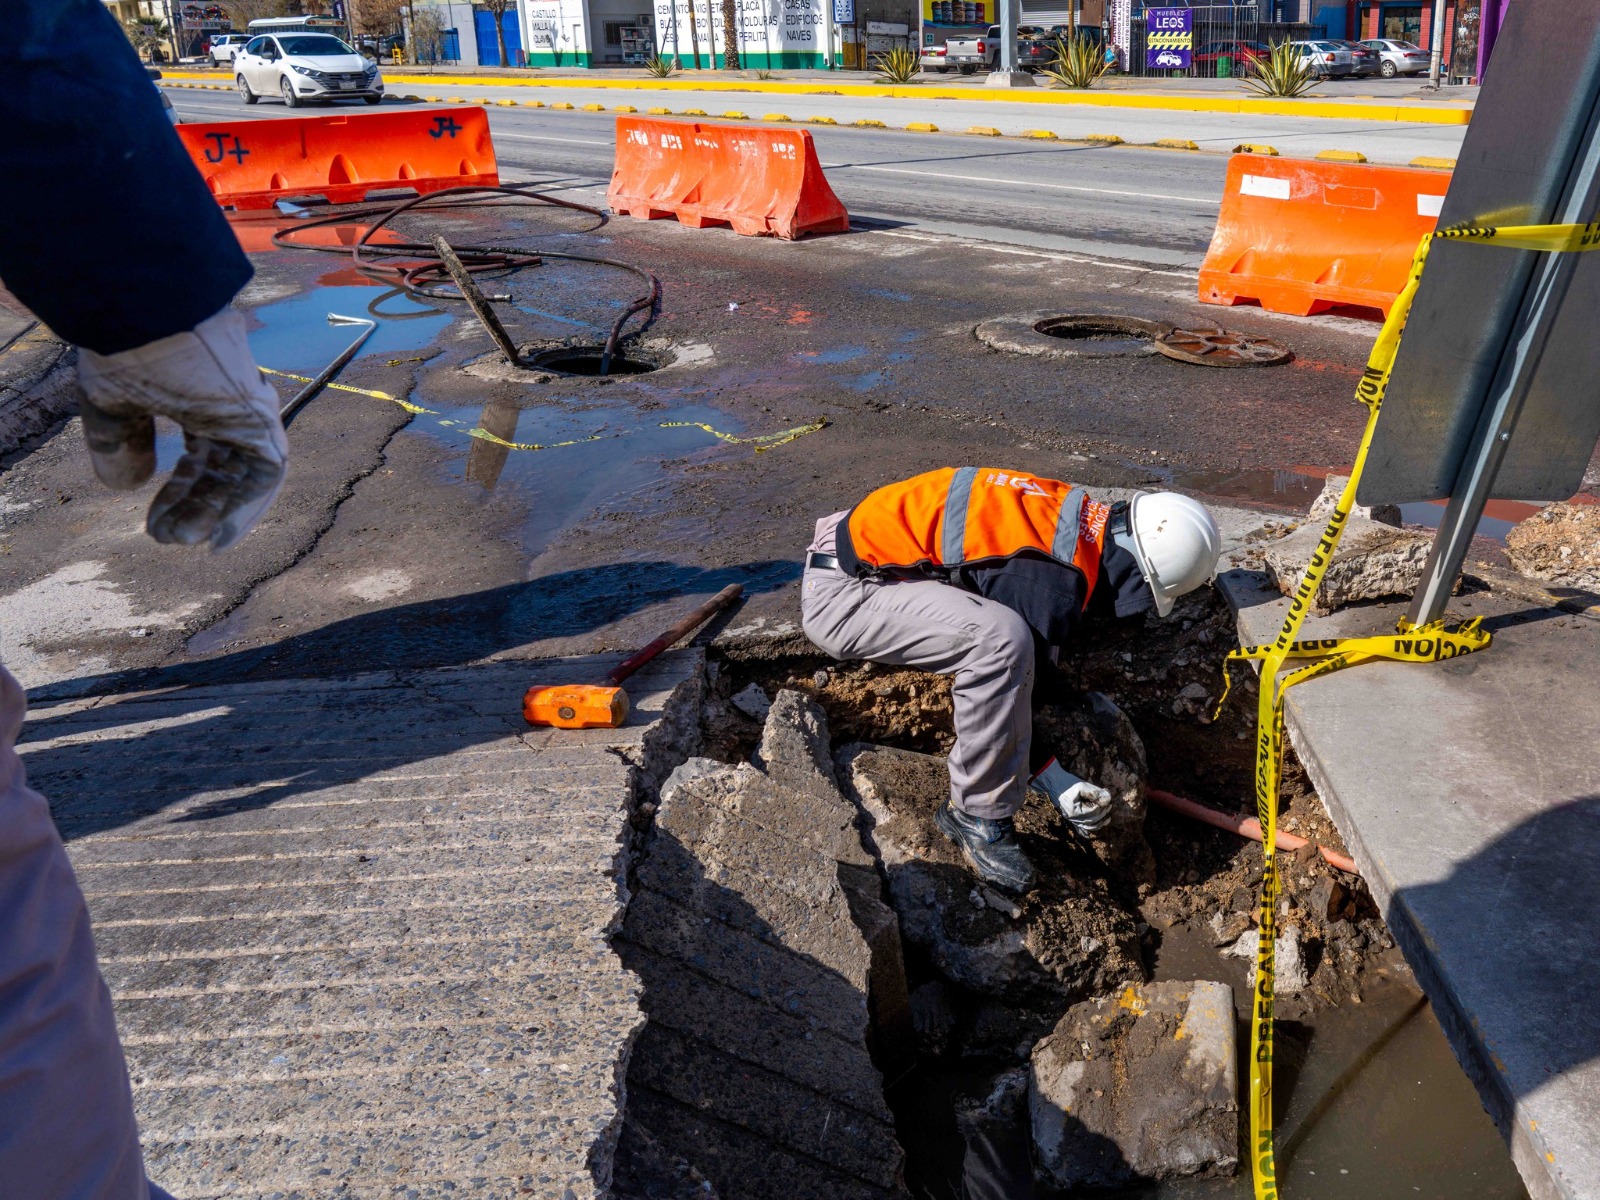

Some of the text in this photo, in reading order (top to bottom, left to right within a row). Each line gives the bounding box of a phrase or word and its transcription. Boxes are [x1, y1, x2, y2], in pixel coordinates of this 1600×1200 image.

[657, 4, 689, 14] CEMNTO
[695, 3, 724, 14] VIGETA
[736, 1, 760, 12] PLACA
[785, 0, 811, 10] CASAS
[532, 9, 556, 18] CASTILLO
[660, 19, 682, 29] BLOK
[737, 15, 778, 27] MOLDURAS
[786, 14, 823, 26] EDIFICIOS
[1156, 17, 1184, 29] LEOS
[739, 31, 767, 41] PERLITA
[786, 30, 812, 41] NAVES
